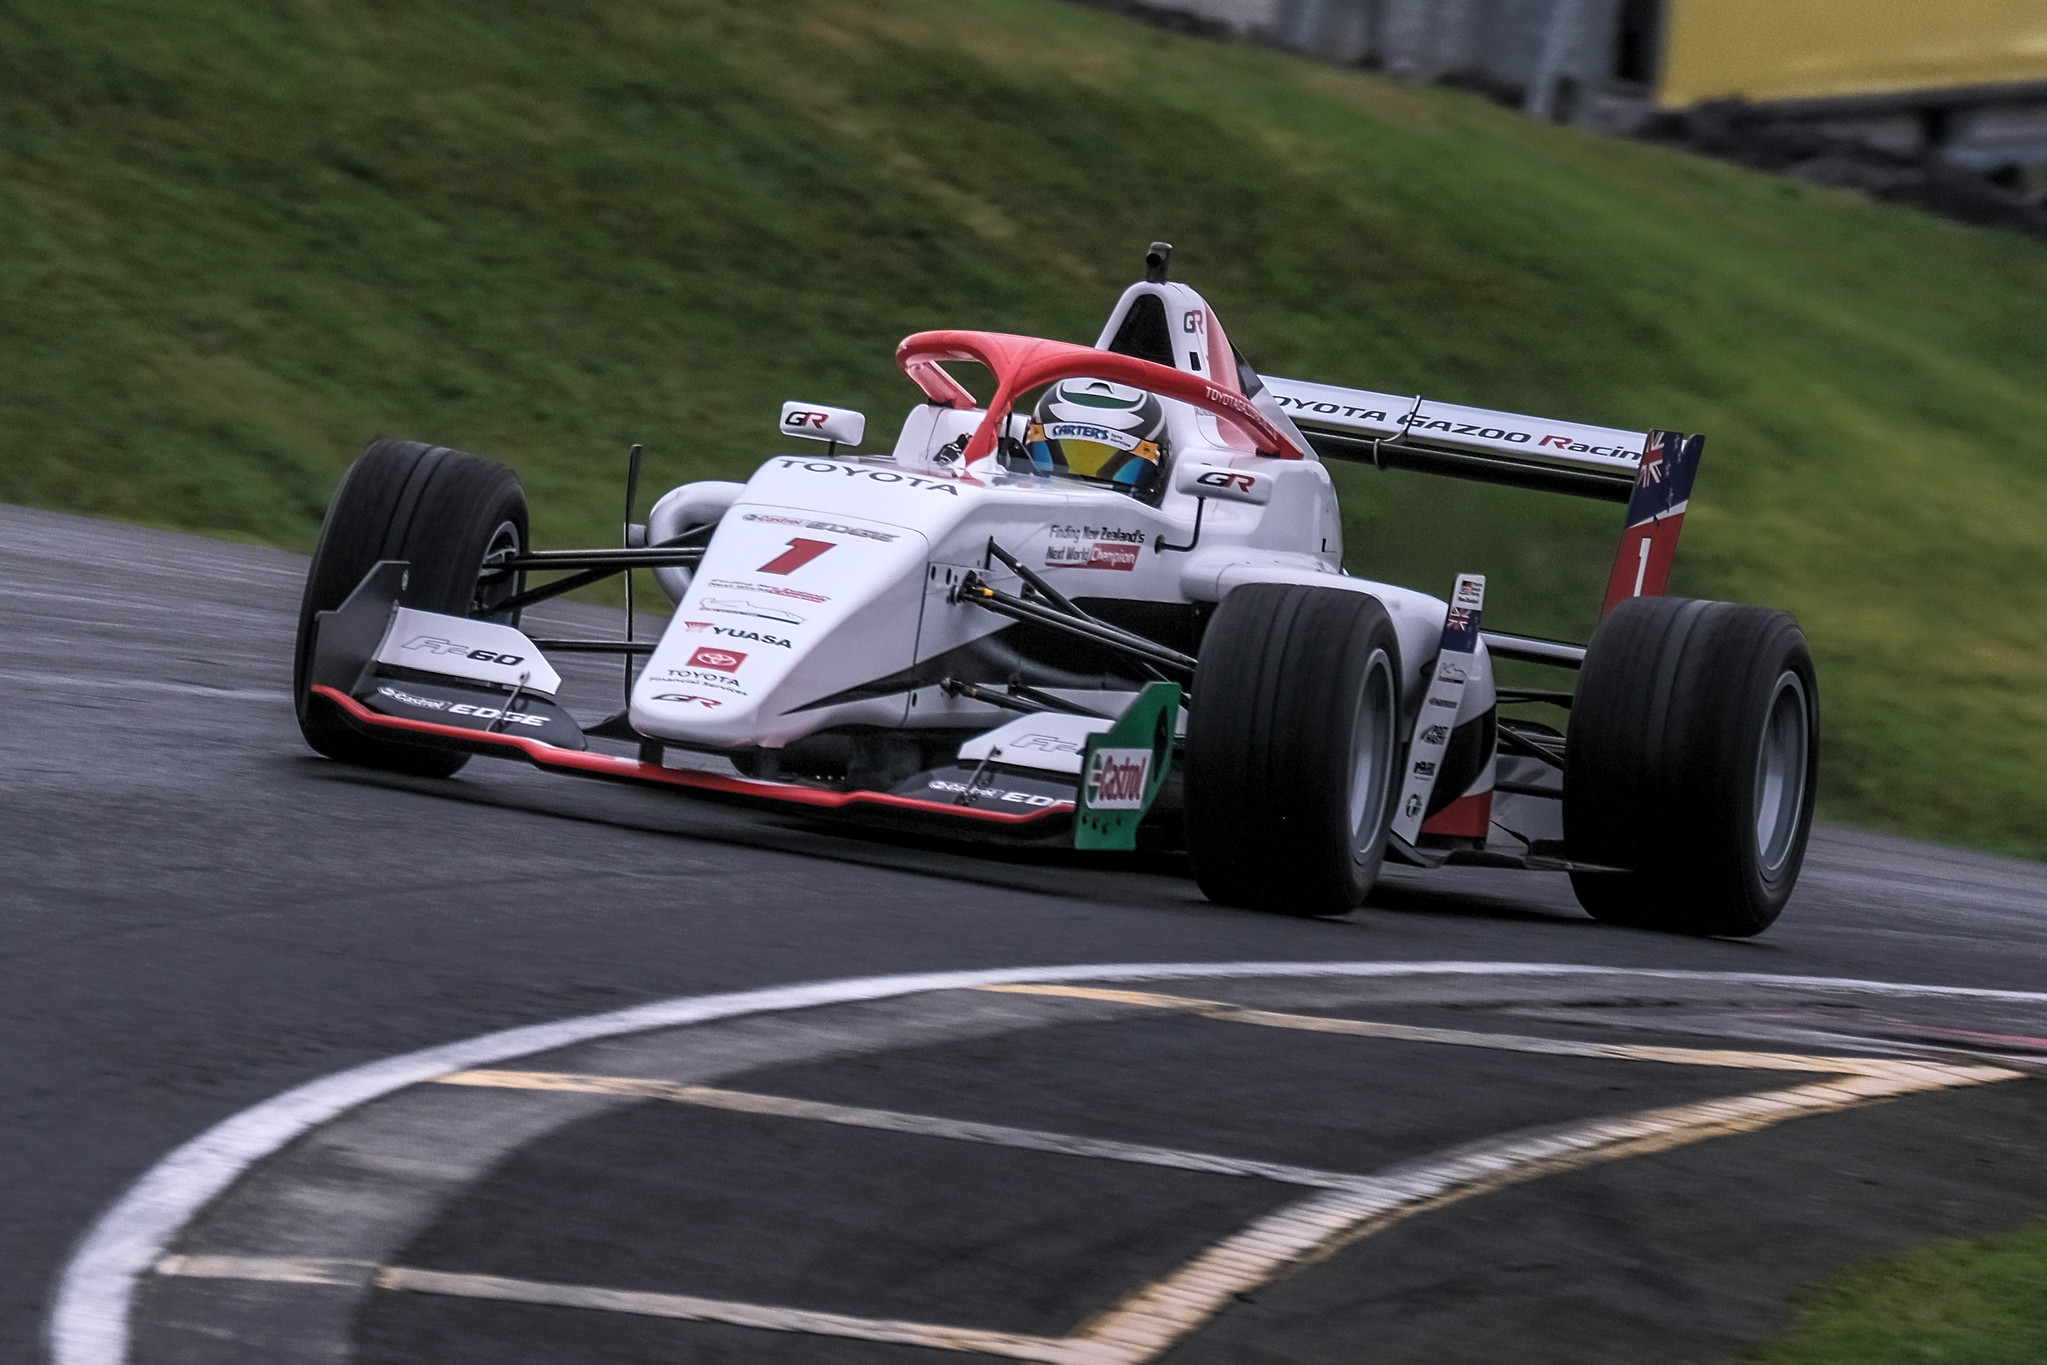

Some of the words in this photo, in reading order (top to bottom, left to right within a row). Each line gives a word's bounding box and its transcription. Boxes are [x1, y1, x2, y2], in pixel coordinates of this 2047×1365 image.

[1183, 310, 1204, 334] GR
[784, 411, 830, 430] GR
[1396, 411, 1532, 444] GAZOO
[1538, 434, 1643, 464] Racin
[779, 458, 959, 497] TOYOTA
[1196, 472, 1256, 494] GR
[1101, 526, 1146, 543] Zealand's
[756, 537, 838, 575] 1
[1091, 547, 1135, 567] Champion
[1632, 537, 1652, 598] 1
[712, 626, 793, 650] YUASA
[668, 669, 740, 688] TOYOTA
[650, 693, 723, 710] GR
[449, 703, 552, 728] EDGE
[1098, 755, 1147, 801] Castrol
